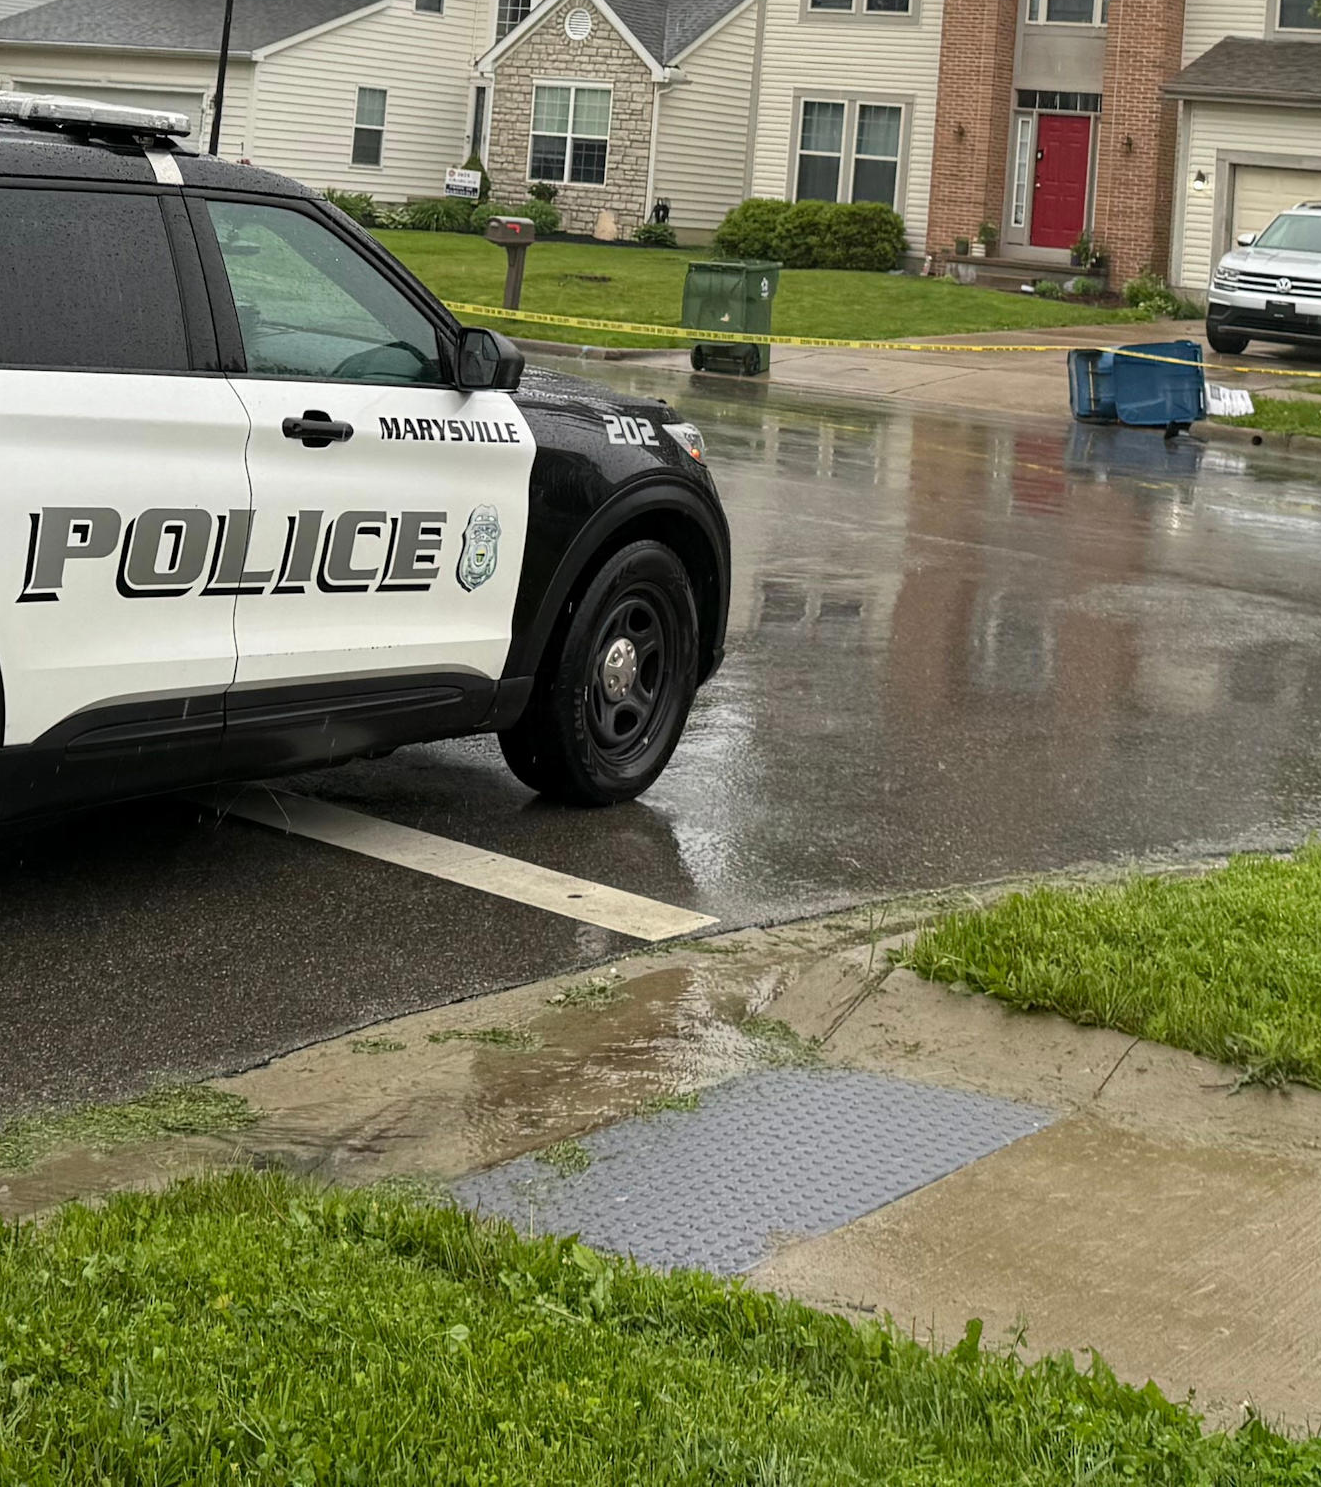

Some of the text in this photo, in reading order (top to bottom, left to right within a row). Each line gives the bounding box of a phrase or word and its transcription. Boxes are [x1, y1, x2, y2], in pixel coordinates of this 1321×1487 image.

[378, 417, 520, 443] MARYSVILLE
[602, 414, 660, 446] 202
[16, 506, 448, 603] POLICE
